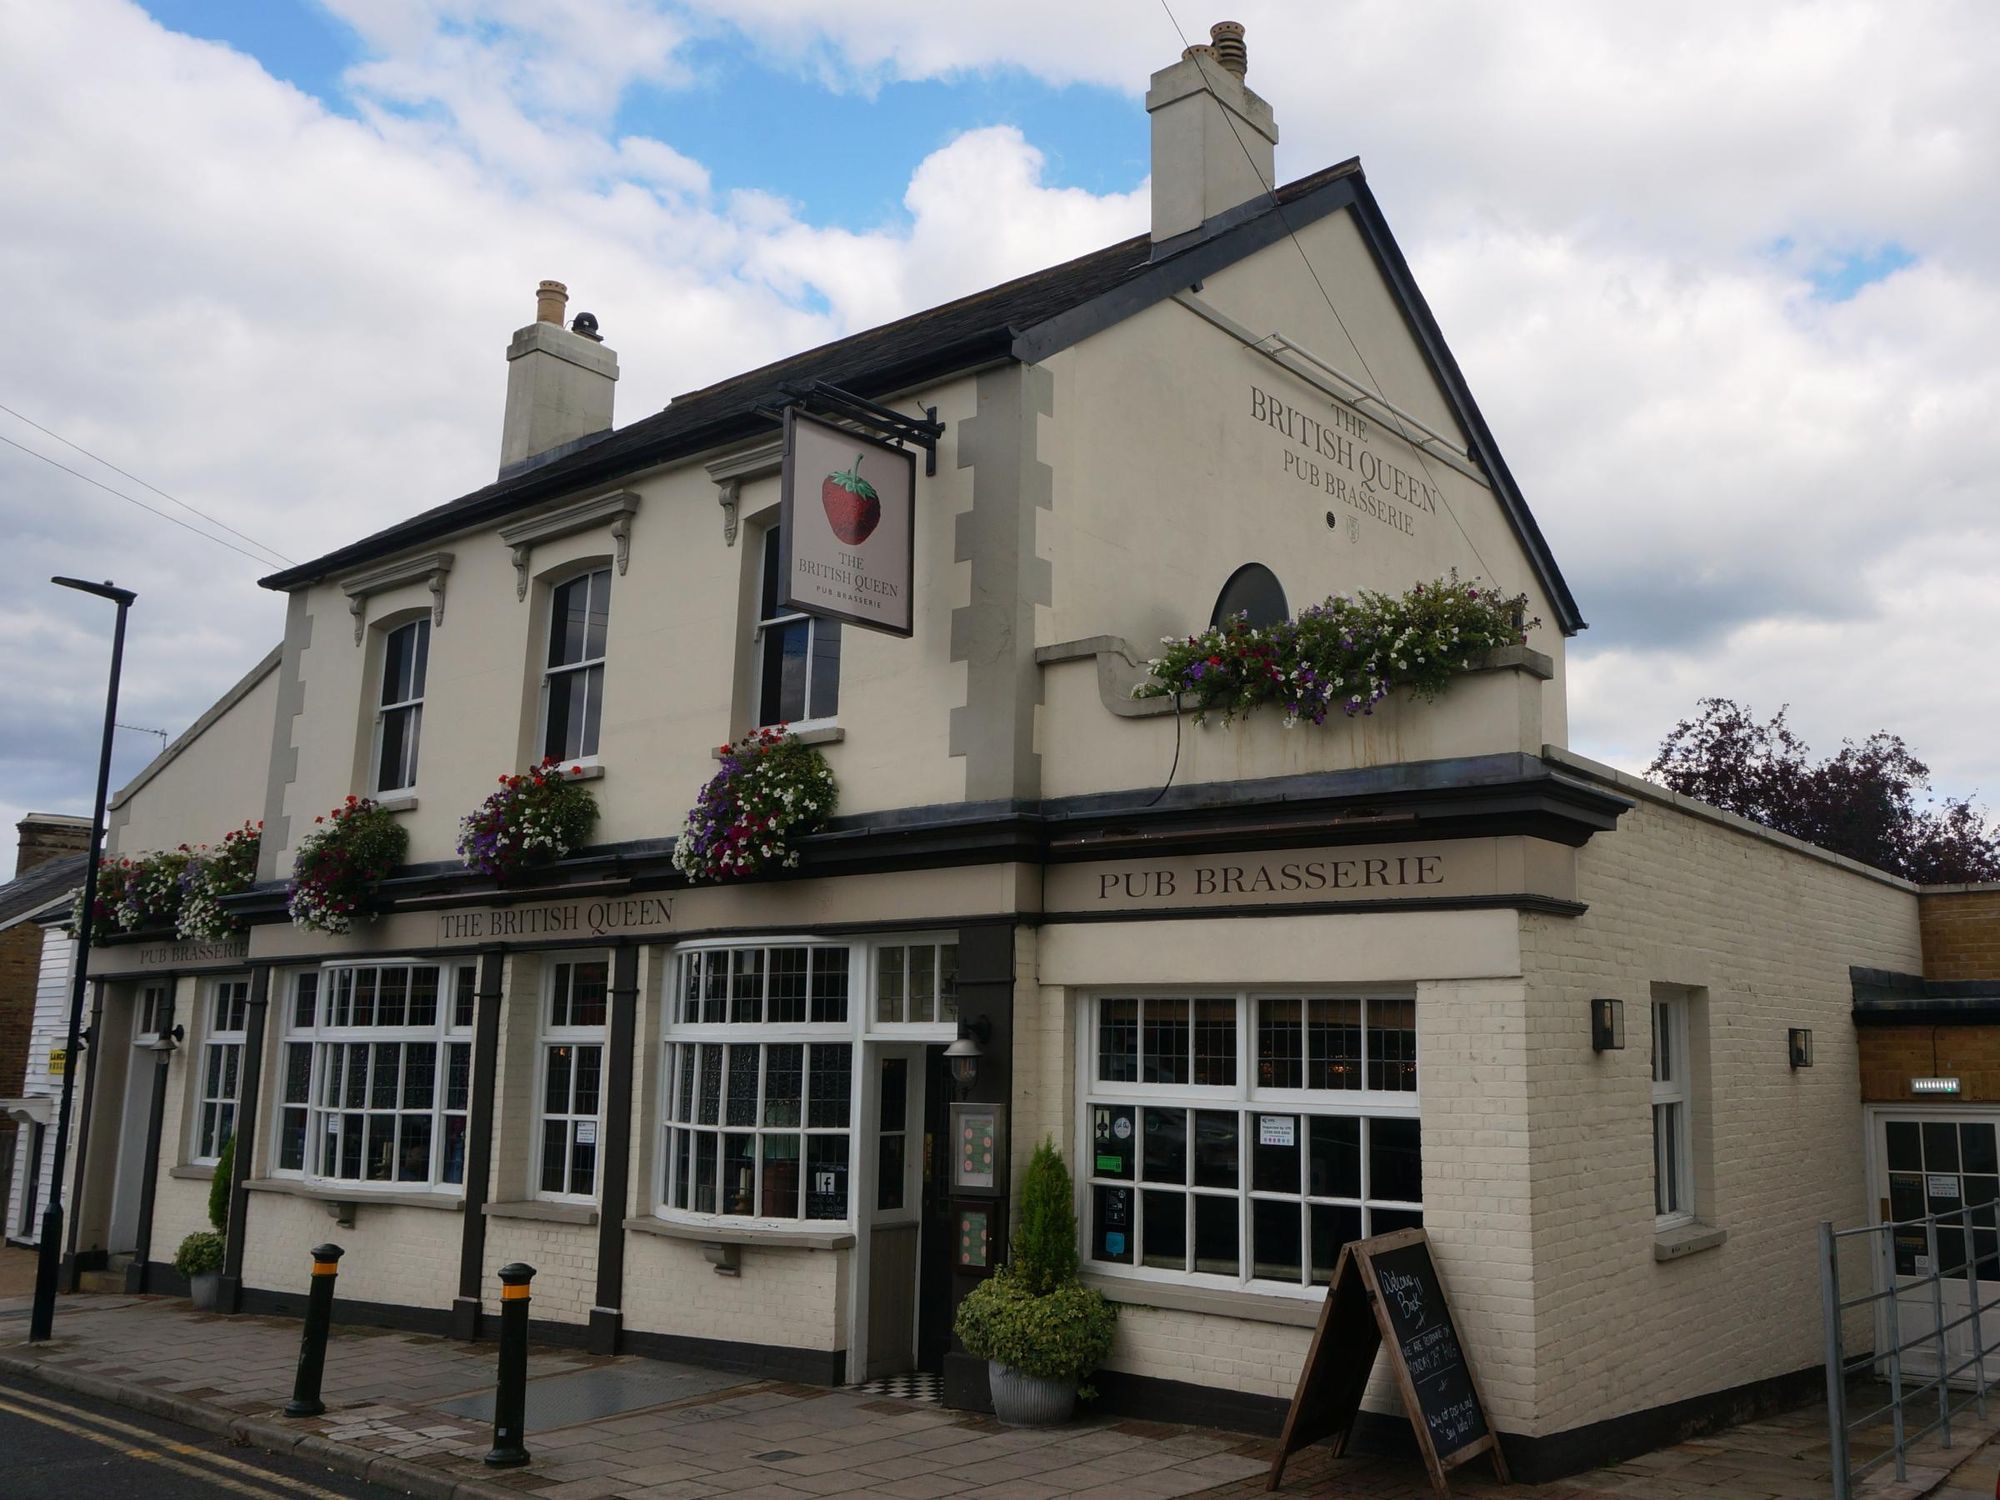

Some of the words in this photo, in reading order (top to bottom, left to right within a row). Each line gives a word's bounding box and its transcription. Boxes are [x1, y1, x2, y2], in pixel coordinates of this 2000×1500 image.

[1331, 403, 1368, 444] THE
[1250, 385, 1354, 472] BRITISH
[1359, 450, 1437, 516] QUEEN
[1283, 449, 1320, 487] PUB
[1325, 471, 1414, 537] BRASSERIE
[799, 558, 852, 585] BRITISH
[854, 574, 898, 597] QUEEN
[838, 552, 865, 570] THE
[816, 585, 833, 595] PUB
[836, 591, 881, 608] BRASSERIE
[1099, 870, 1176, 899] PUB
[1194, 855, 1445, 895] BRASSERIE
[441, 912, 483, 939] THE
[490, 905, 579, 936] BRITISH
[587, 897, 675, 935] QUEEN
[140, 948, 167, 965] PUB
[172, 942, 249, 963] BRASSERIE
[1397, 1291, 1422, 1319] Back
